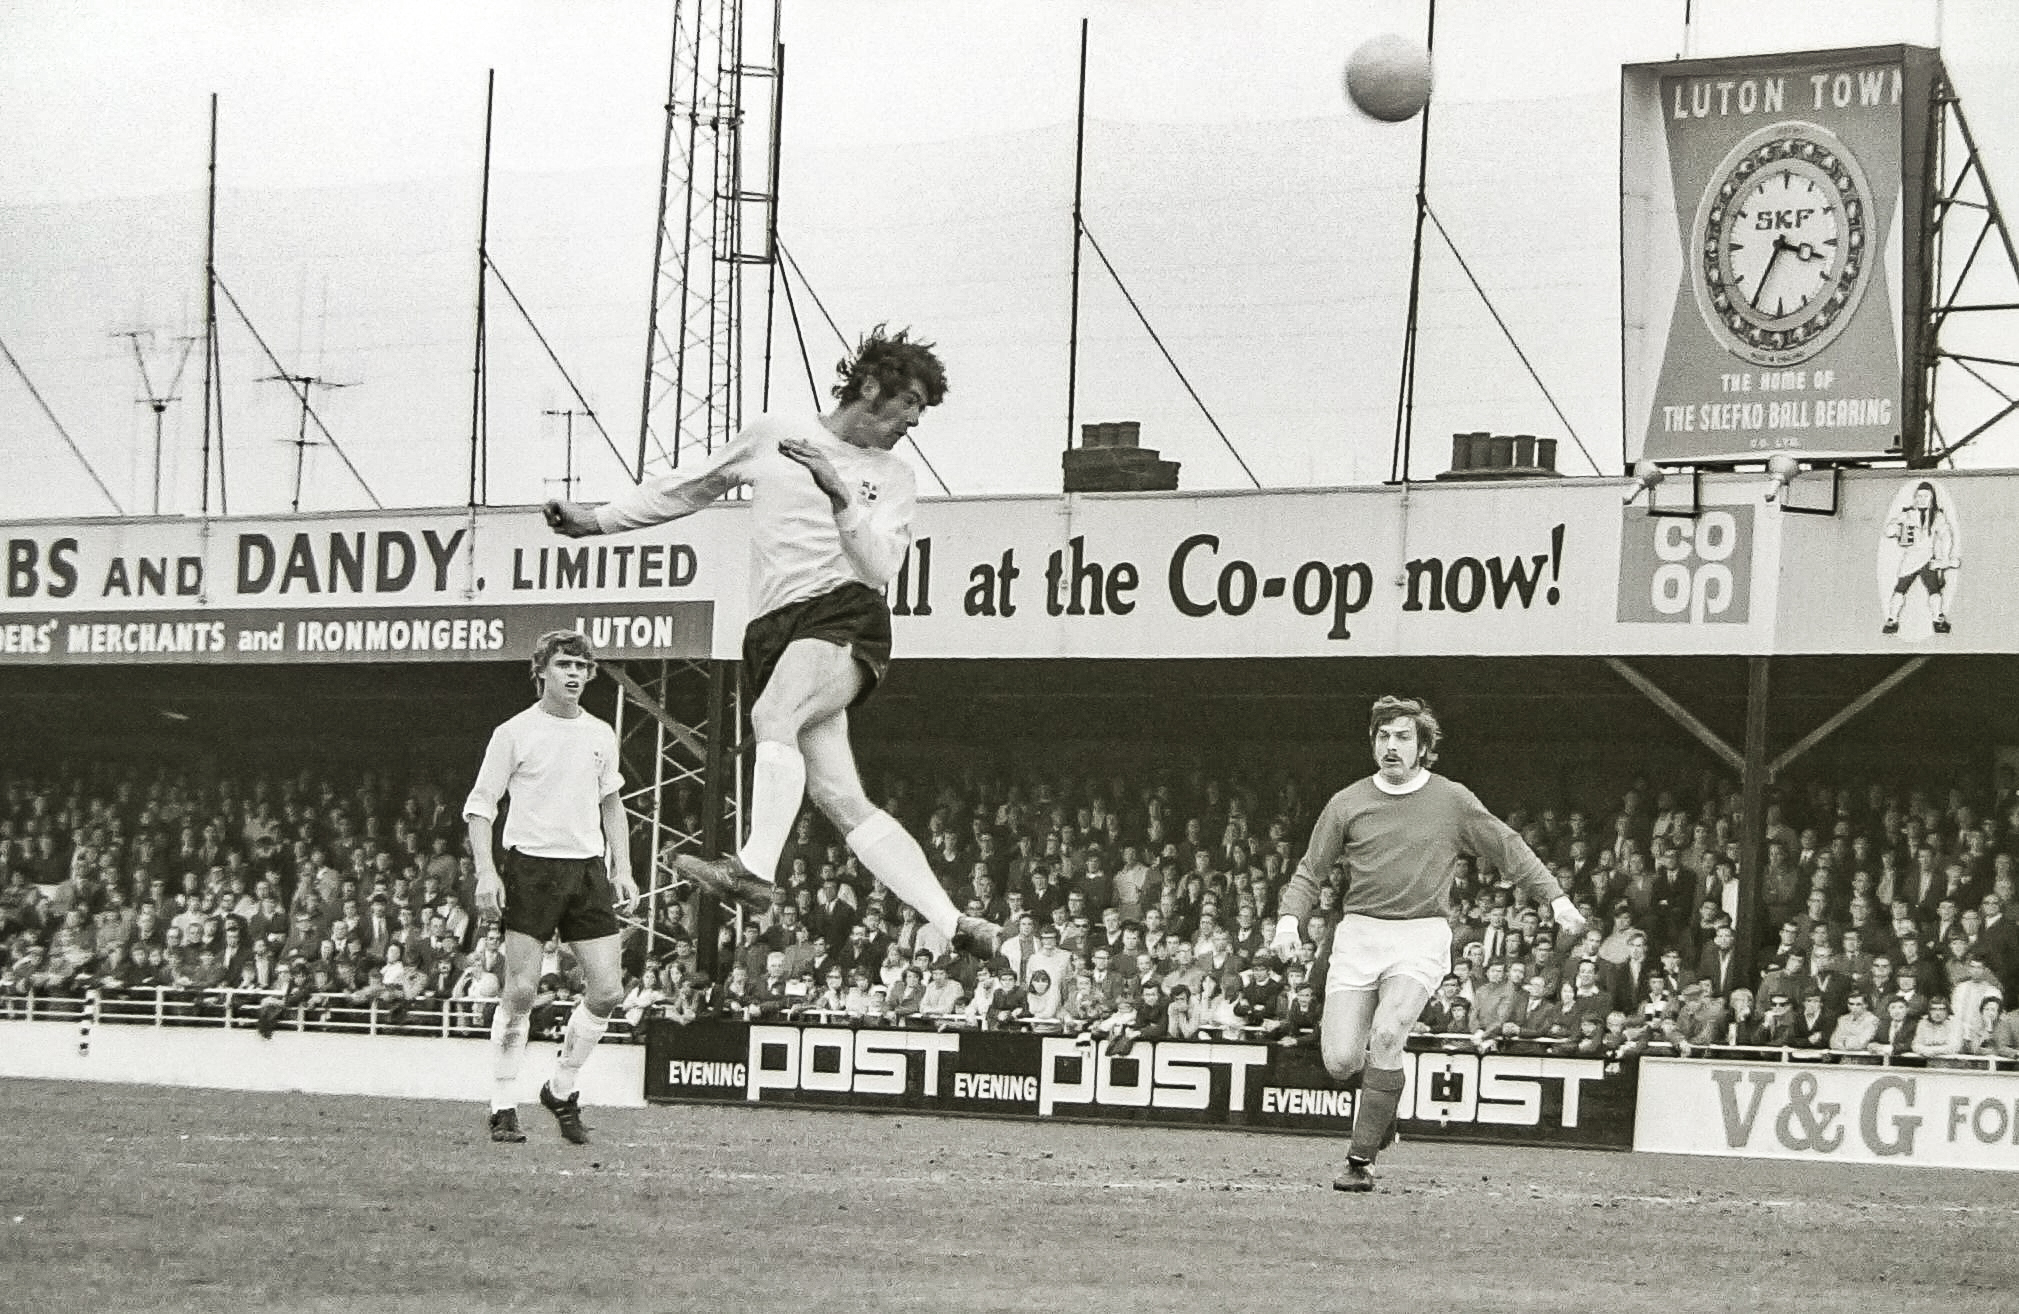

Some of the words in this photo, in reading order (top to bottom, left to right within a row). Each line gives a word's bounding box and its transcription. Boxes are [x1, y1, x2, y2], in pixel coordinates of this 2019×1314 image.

[1673, 77, 1785, 119] LUTON
[1755, 208, 1815, 231] SKF
[1721, 373, 1751, 392] THE
[1760, 371, 1806, 391] HOME
[1814, 369, 1834, 389] OF
[1663, 404, 1695, 432] THE
[1700, 402, 1762, 431] SKEFKO
[1768, 400, 1810, 428] BALL
[1815, 399, 1891, 428] BEARING
[102, 557, 203, 597] AND
[513, 543, 697, 590] LIMITED
[964, 547, 1020, 618] at
[1045, 535, 1139, 617] the
[1168, 533, 1373, 640] Co-op
[1402, 524, 1566, 612] now!
[66, 620, 225, 653] MERCHANTS
[238, 622, 284, 651] and
[298, 617, 504, 652] IRONMONGERS
[669, 1060, 746, 1087] EVENING
[954, 1072, 1038, 1101] EVENING
[1262, 1086, 1352, 1117] EVENING
[1946, 1095, 2019, 1146] FO
